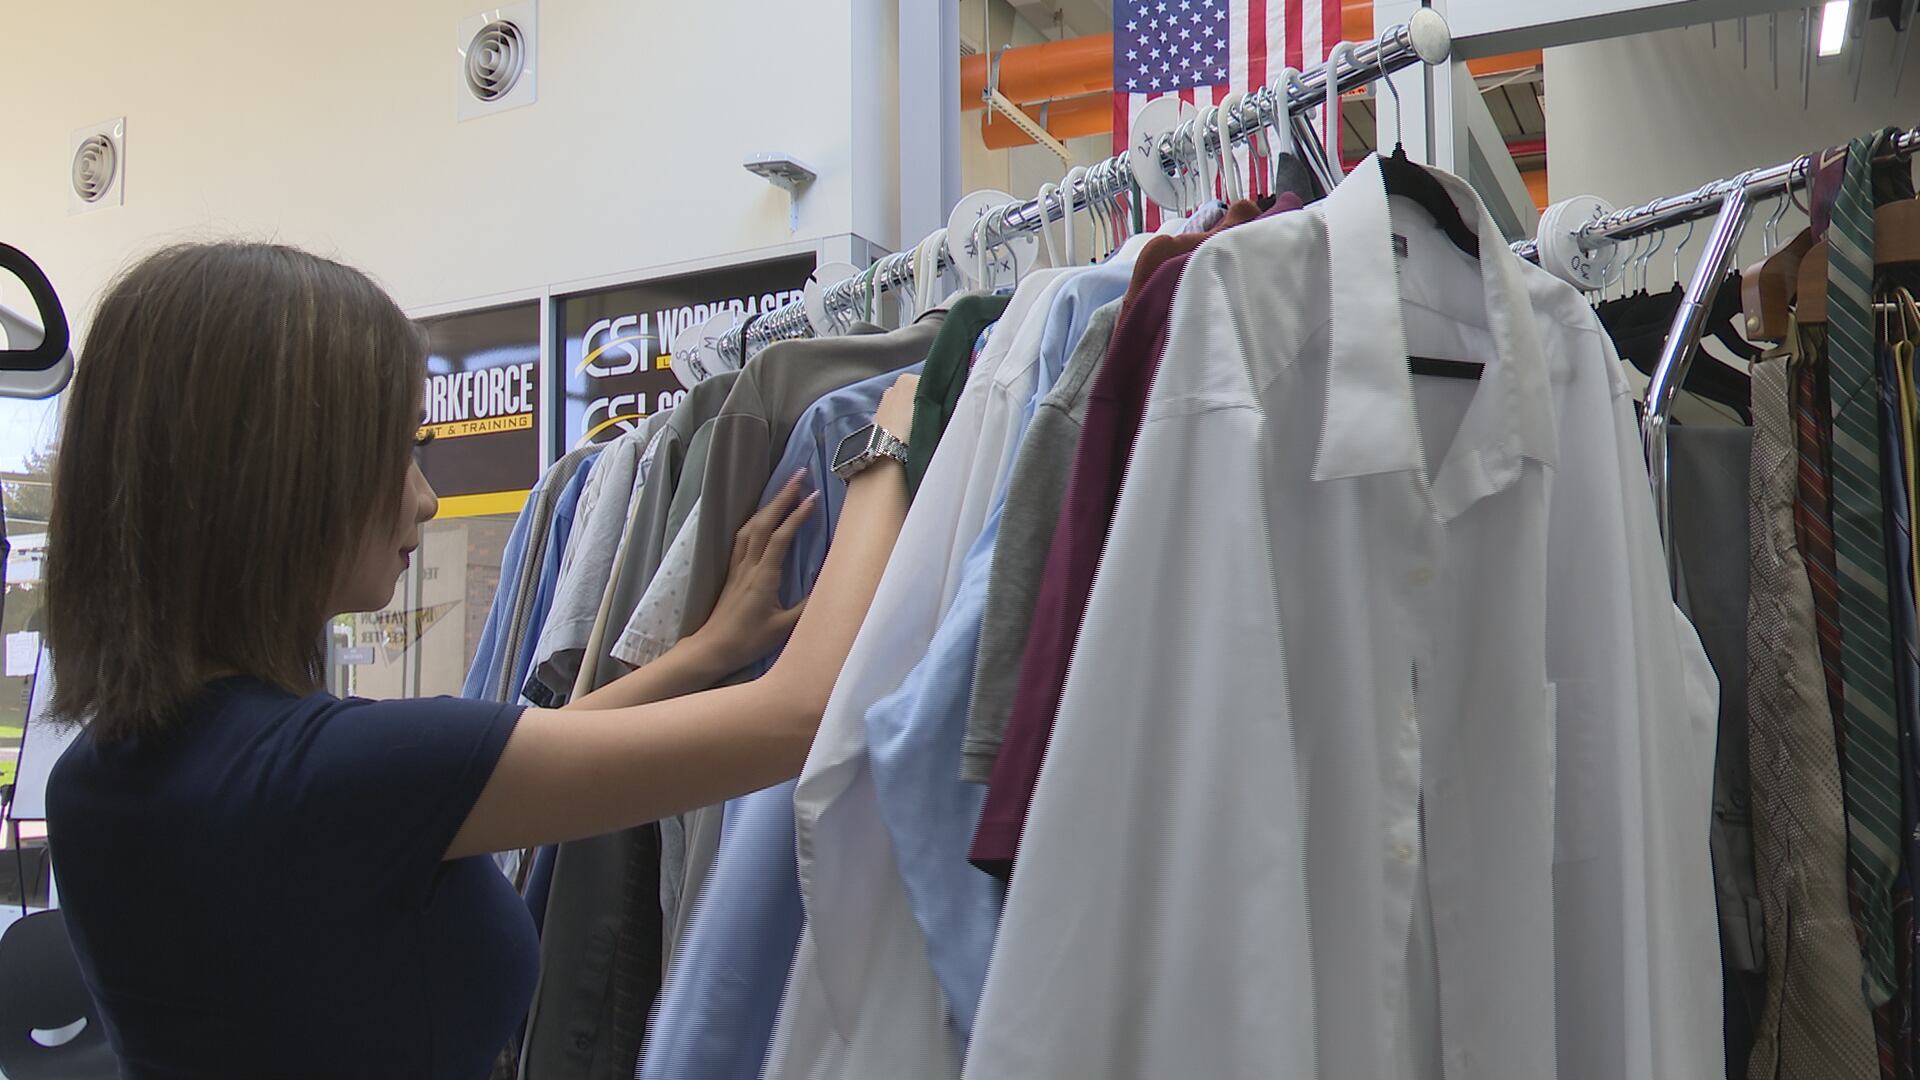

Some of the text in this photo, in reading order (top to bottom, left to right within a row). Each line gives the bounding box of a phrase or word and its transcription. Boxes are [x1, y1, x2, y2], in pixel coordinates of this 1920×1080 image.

[581, 313, 649, 379] CSI
[422, 362, 534, 426] ORKFORCE
[462, 416, 528, 433] TRAINING
